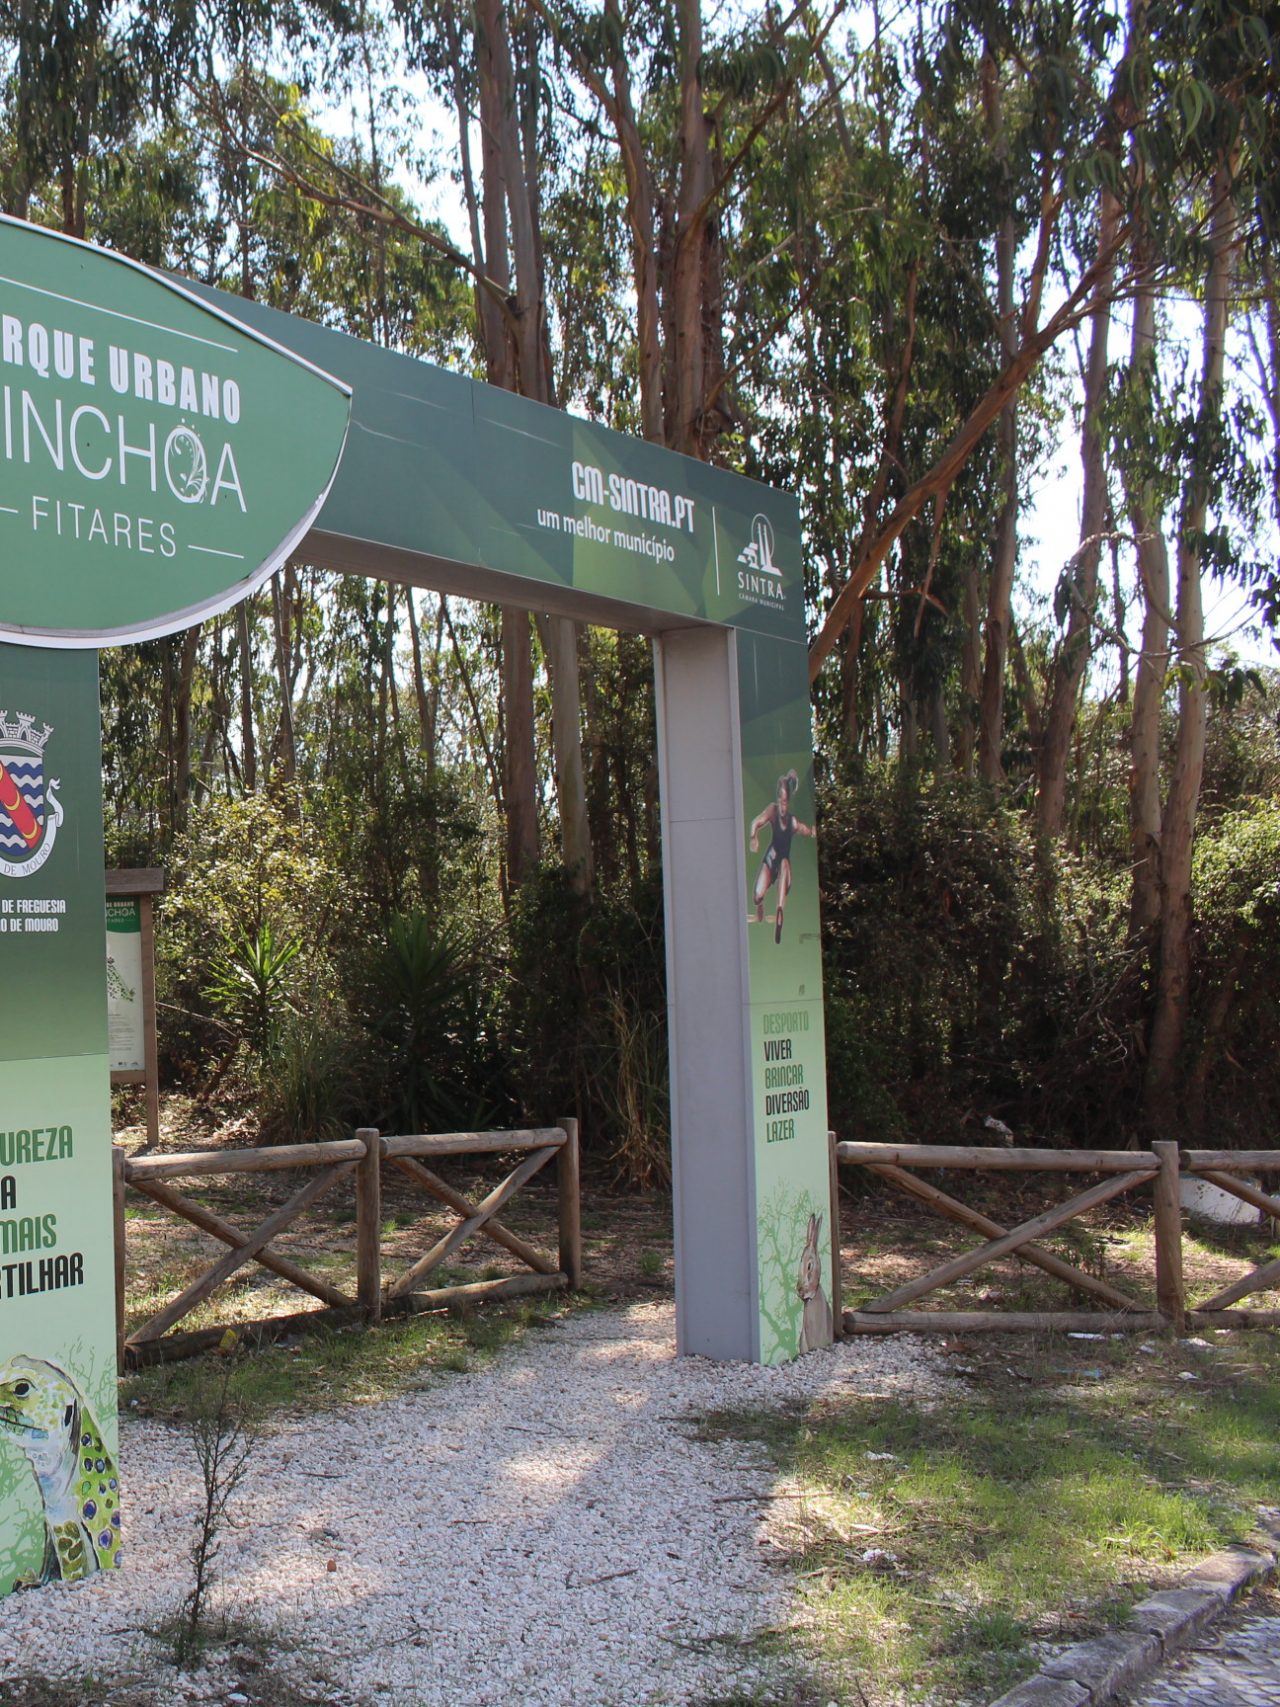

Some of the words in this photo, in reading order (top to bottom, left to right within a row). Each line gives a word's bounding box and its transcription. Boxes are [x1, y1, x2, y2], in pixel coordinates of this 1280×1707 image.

[108, 345, 241, 424] URBANO
[571, 460, 695, 533] CM-SINTRA.PT
[32, 495, 177, 558] FITARES
[536, 508, 560, 531] um
[562, 515, 611, 544] melhor
[613, 529, 675, 564] município
[737, 571, 784, 600] SINTRA
[3, 863, 18, 876] DE
[22, 843, 51, 873] MOURO
[1, 899, 15, 914] DE
[16, 899, 66, 914] FREGUESIA
[9, 918, 23, 933] DE
[24, 917, 59, 932] MOURO
[763, 1010, 810, 1035] DESPORTO
[763, 1038, 792, 1062] VIVER
[764, 1064, 804, 1089] BRINCAR
[765, 1086, 810, 1116] DIVERSÃO
[766, 1118, 795, 1143] LAZER
